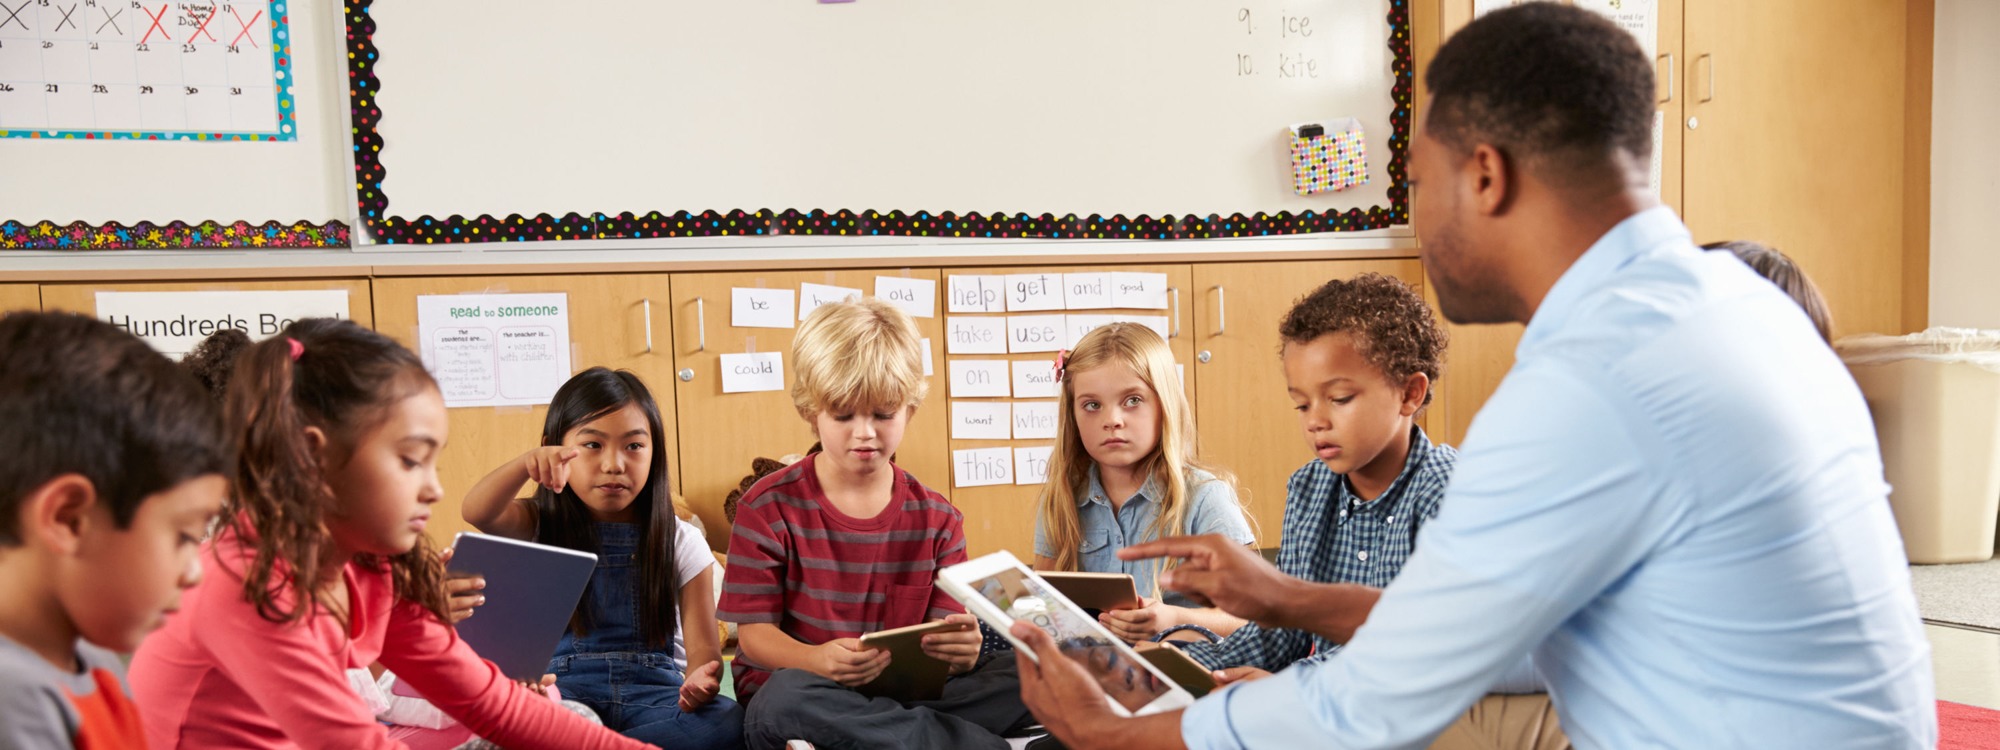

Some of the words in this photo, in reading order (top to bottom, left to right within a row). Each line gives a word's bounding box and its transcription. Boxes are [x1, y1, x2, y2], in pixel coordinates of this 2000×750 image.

[86, 0, 96, 8] 14
[131, 0, 142, 9] 15
[177, 2, 189, 10] 16
[222, 4, 232, 13] 17
[178, 16, 202, 30] Due
[1282, 9, 1313, 38] ice
[42, 40, 54, 49] 20
[89, 42, 99, 50] 21
[137, 43, 150, 52] 22
[182, 44, 197, 53] 23
[227, 45, 240, 54] 24
[0, 83, 14, 92] 26
[45, 83, 59, 93] 27
[92, 84, 108, 93] 28
[139, 85, 153, 94] 29
[184, 86, 199, 95] 30
[230, 87, 242, 95] 31
[1016, 274, 1049, 303] get
[1073, 278, 1103, 296] and
[1120, 281, 1145, 295] good
[889, 289, 914, 302] old
[952, 277, 997, 312] help
[750, 297, 770, 311] be
[450, 305, 481, 319] Read
[484, 309, 495, 318] to
[109, 313, 249, 337] Hundreds
[953, 323, 994, 344] take
[1016, 325, 1057, 343] use
[734, 361, 773, 375] could
[965, 369, 991, 386] on
[1025, 372, 1052, 384] said
[965, 414, 994, 425] want
[963, 451, 1007, 481] this
